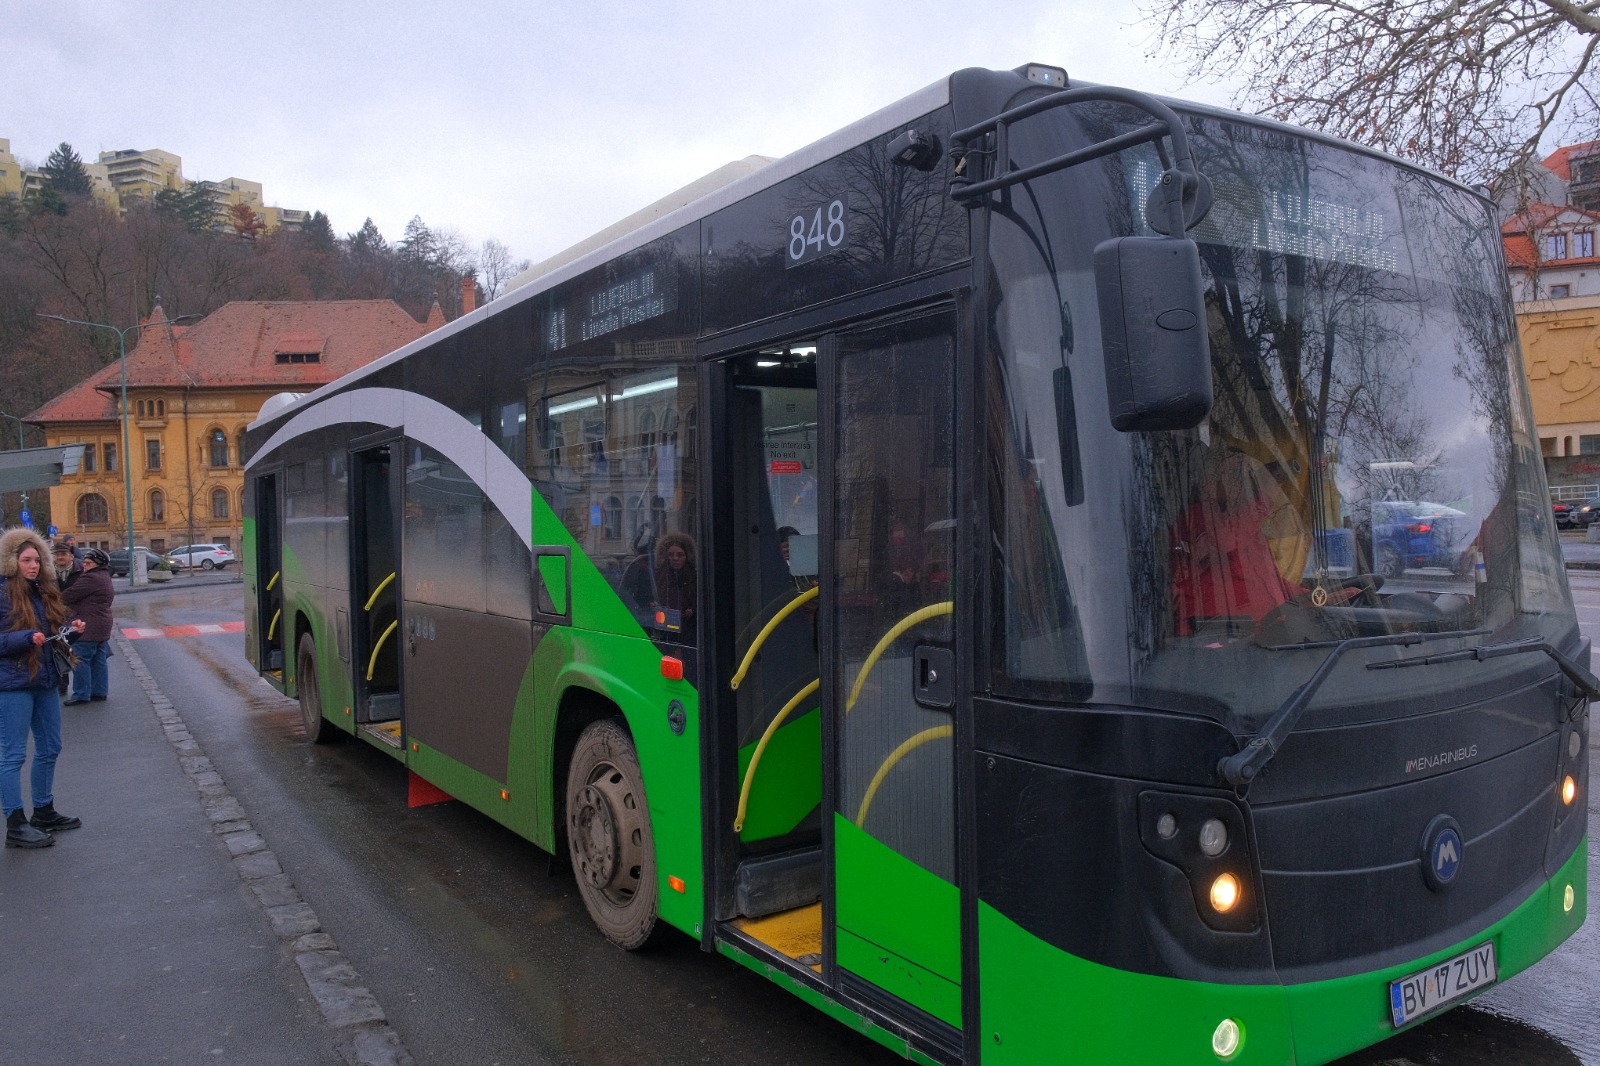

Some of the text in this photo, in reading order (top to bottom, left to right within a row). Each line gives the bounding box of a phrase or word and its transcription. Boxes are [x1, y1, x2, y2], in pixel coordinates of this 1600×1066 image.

[790, 200, 844, 260] 848
[1406, 744, 1478, 773] MENARINIBUS
[1403, 948, 1490, 1015] BV 17 ZUY
